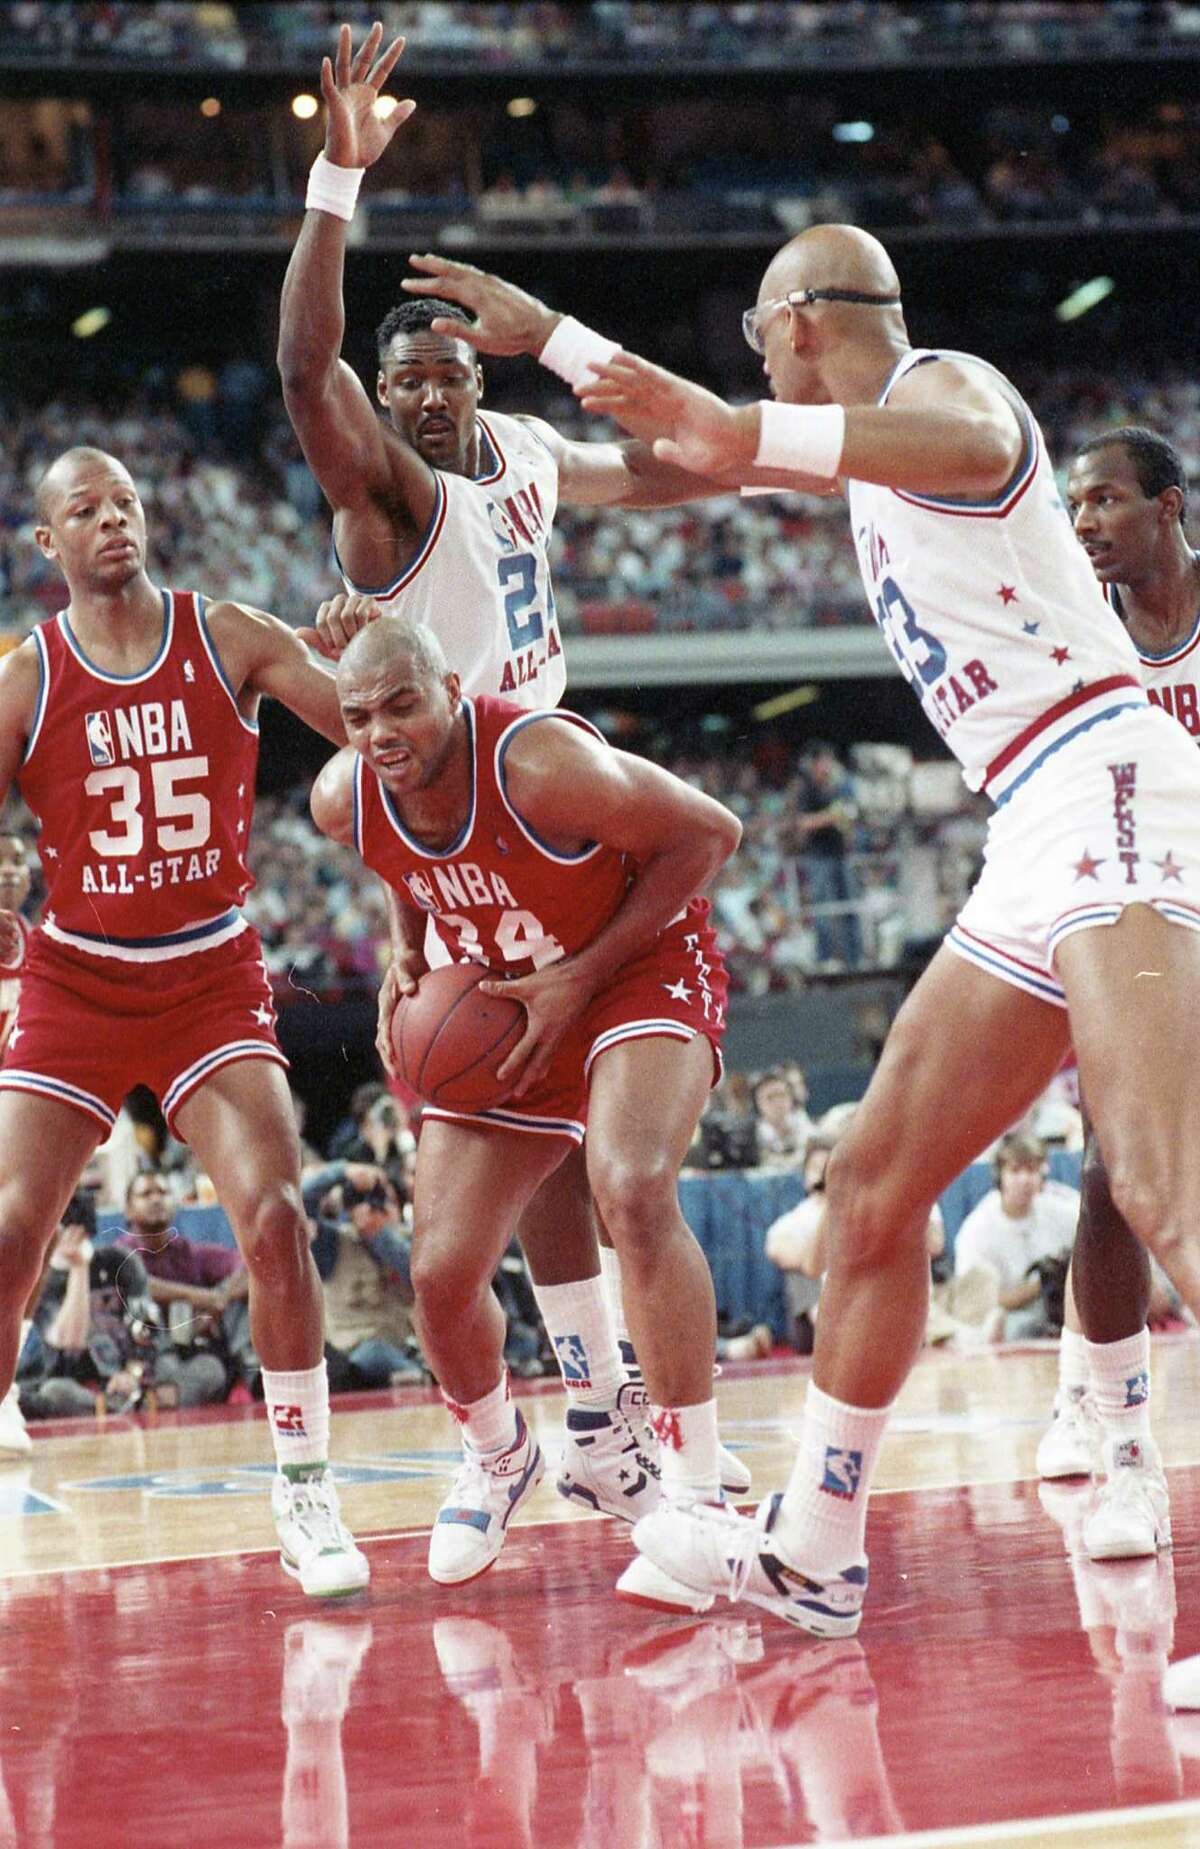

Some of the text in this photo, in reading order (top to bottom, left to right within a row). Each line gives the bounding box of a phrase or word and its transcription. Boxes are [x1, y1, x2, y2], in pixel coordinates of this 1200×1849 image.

[114, 699, 193, 759] NBA
[1147, 683, 1200, 736] NB
[84, 755, 211, 857] 35
[1107, 762, 1140, 884] WEST
[82, 848, 222, 894] ALL-STAR
[432, 862, 519, 909] NBA
